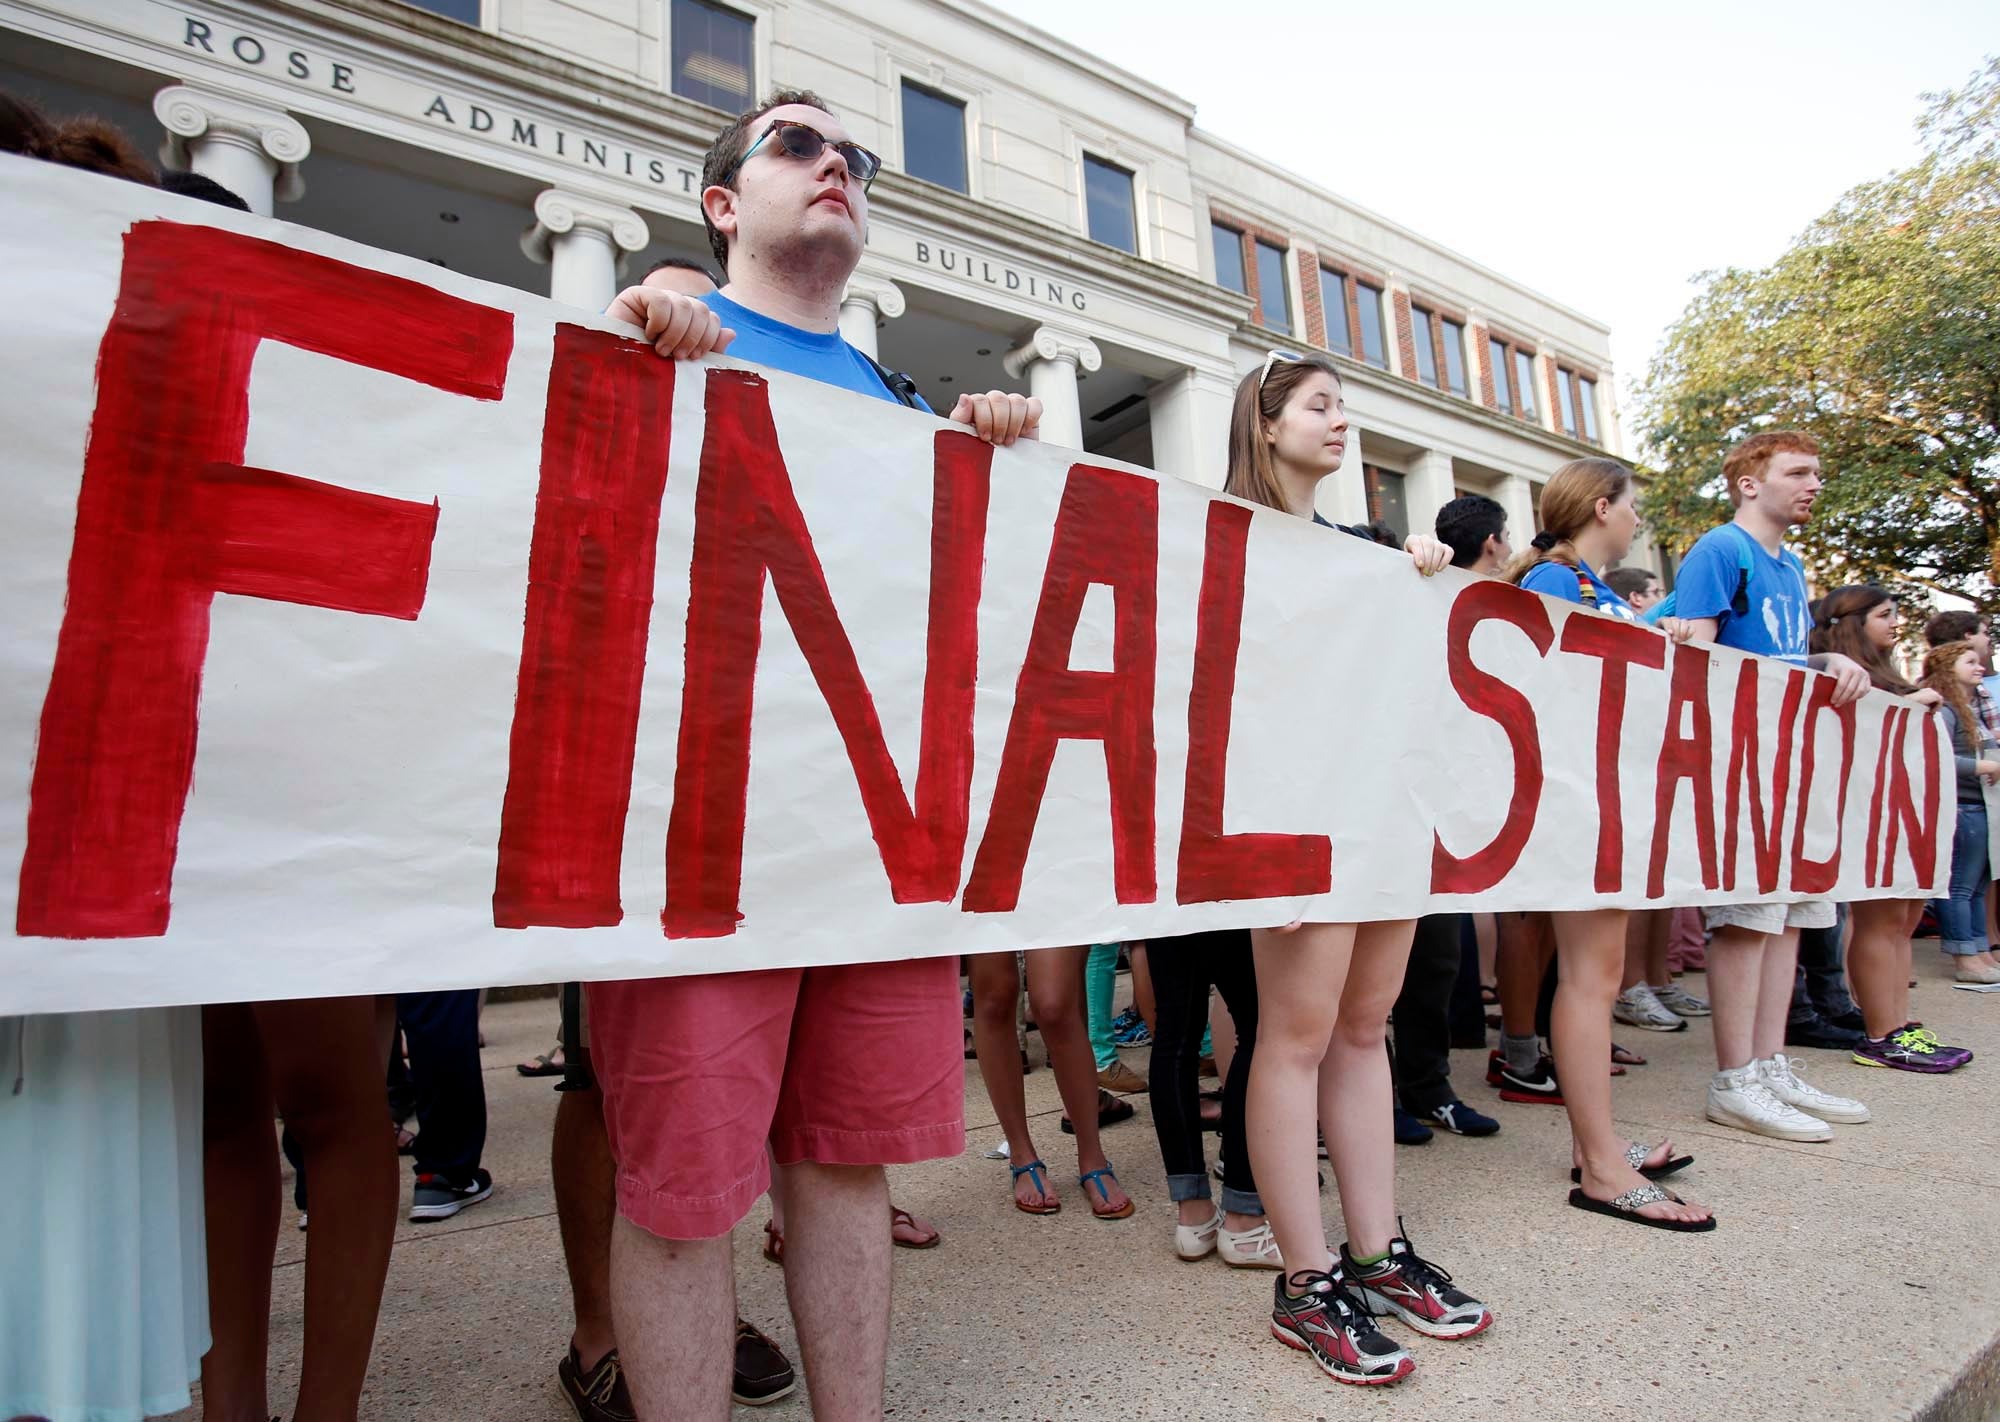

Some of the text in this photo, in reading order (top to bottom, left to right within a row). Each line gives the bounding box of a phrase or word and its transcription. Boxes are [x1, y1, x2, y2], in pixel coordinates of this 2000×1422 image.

[184, 17, 356, 94] ROSE
[916, 241, 1086, 311] BUILDING
[16, 218, 1332, 940] FINAL
[1430, 580, 1857, 898] STAND
